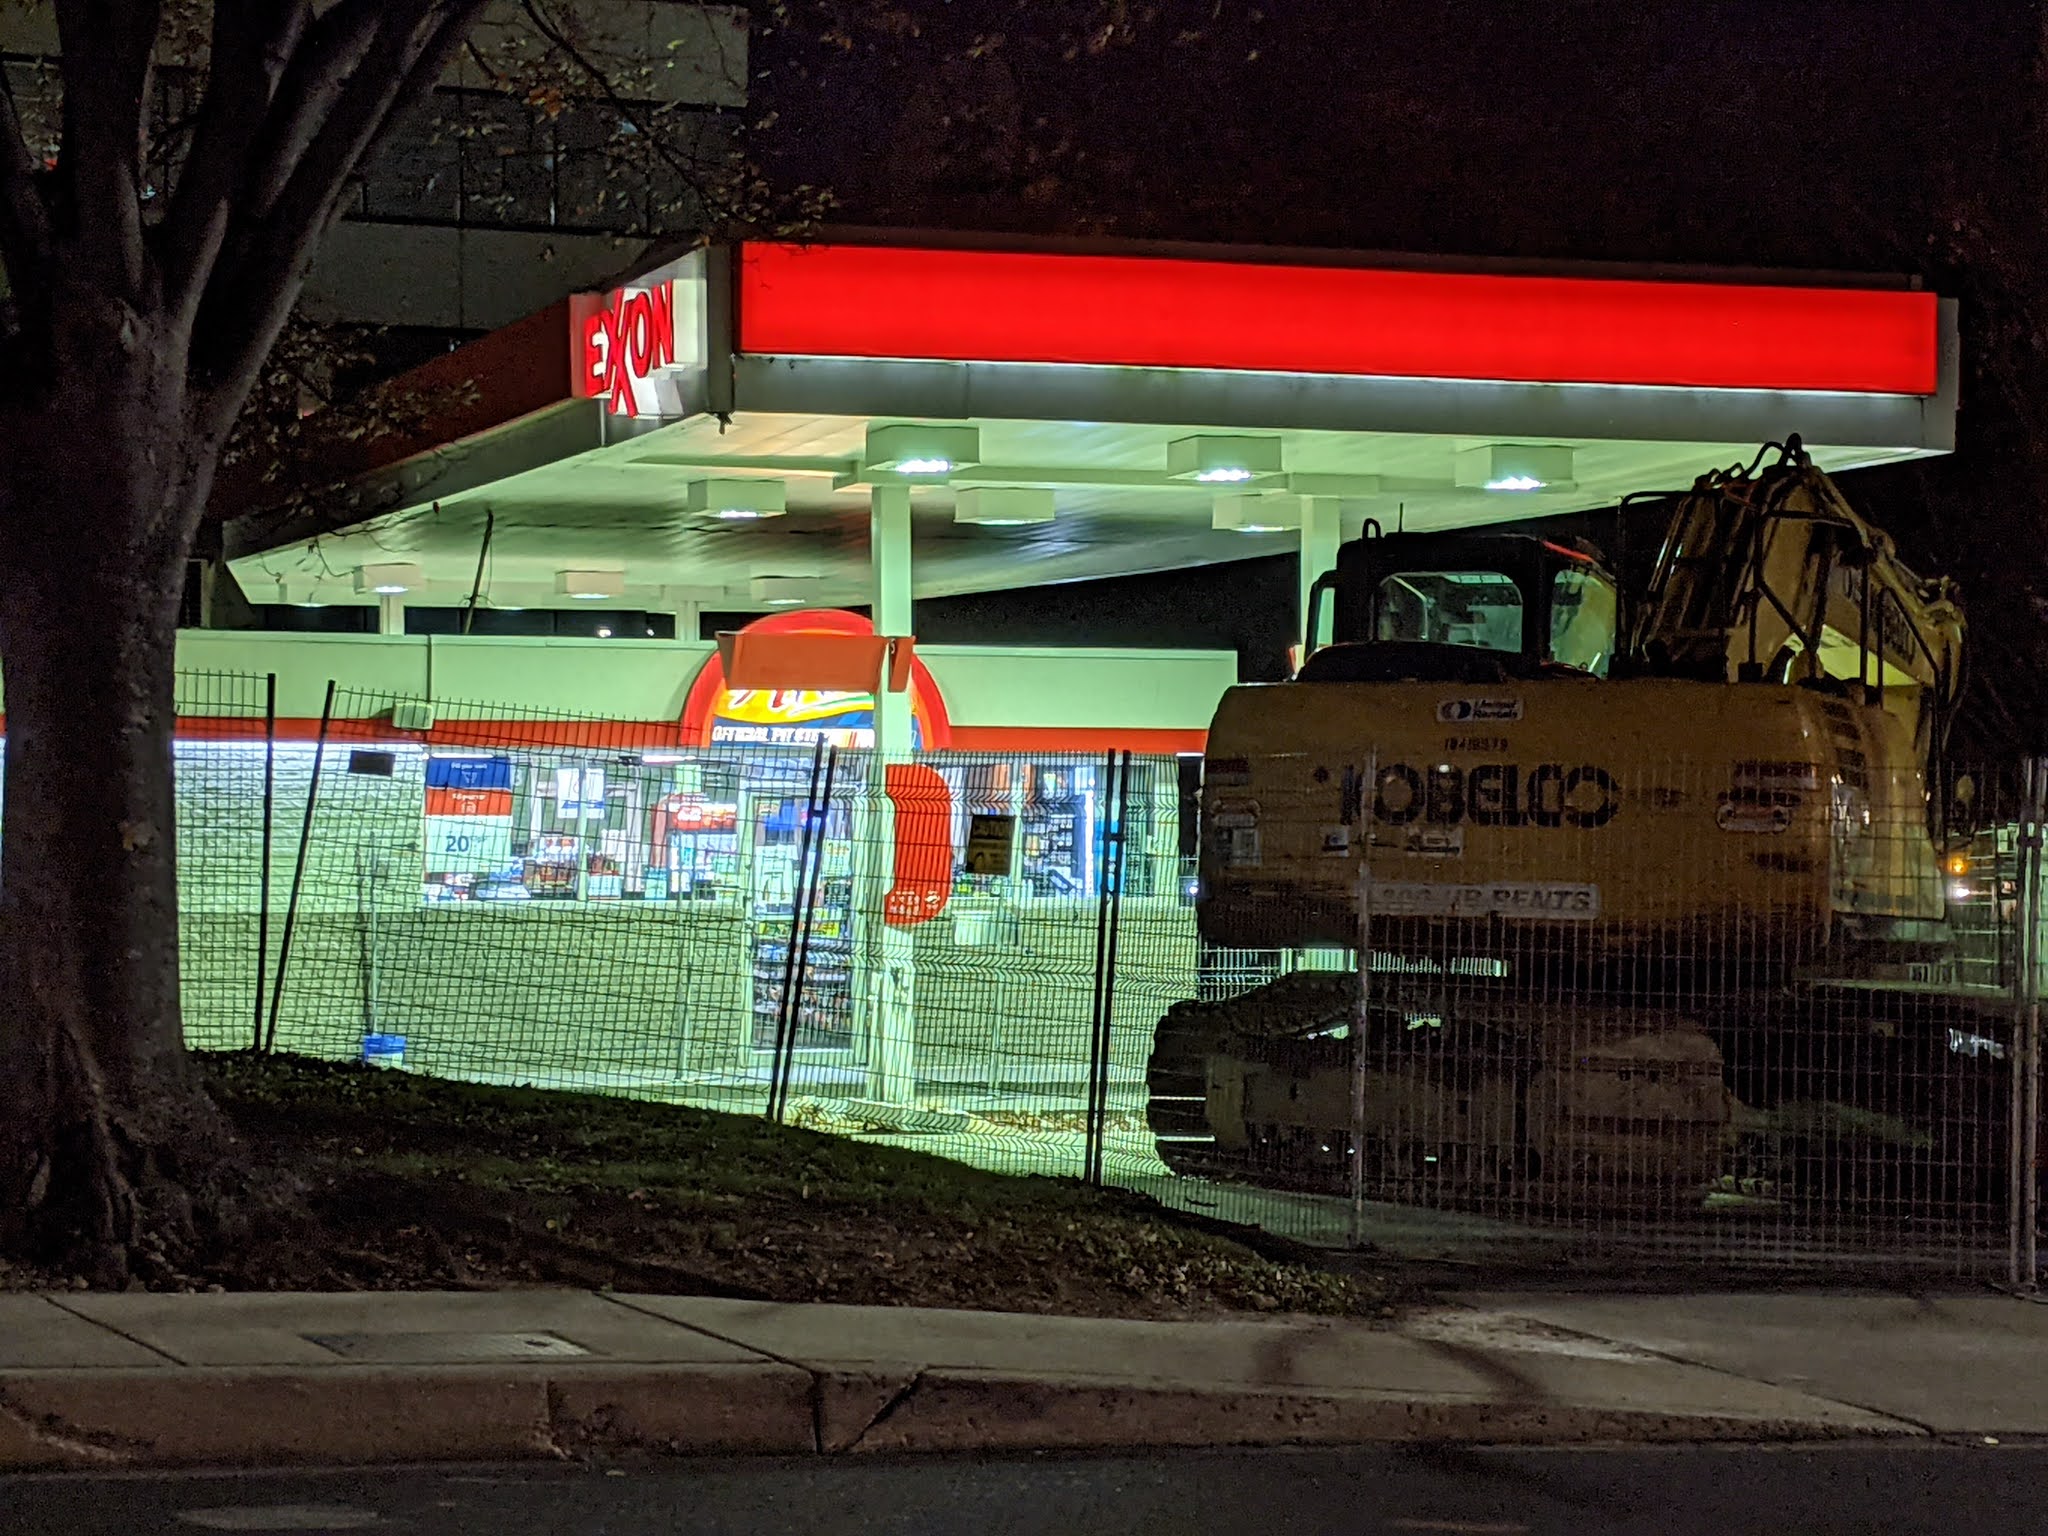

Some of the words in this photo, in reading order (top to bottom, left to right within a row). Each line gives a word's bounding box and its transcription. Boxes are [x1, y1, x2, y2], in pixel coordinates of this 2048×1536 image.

[583, 279, 675, 419] EXXON
[445, 835, 469, 853] 20
[1492, 888, 1591, 912] RENTS
